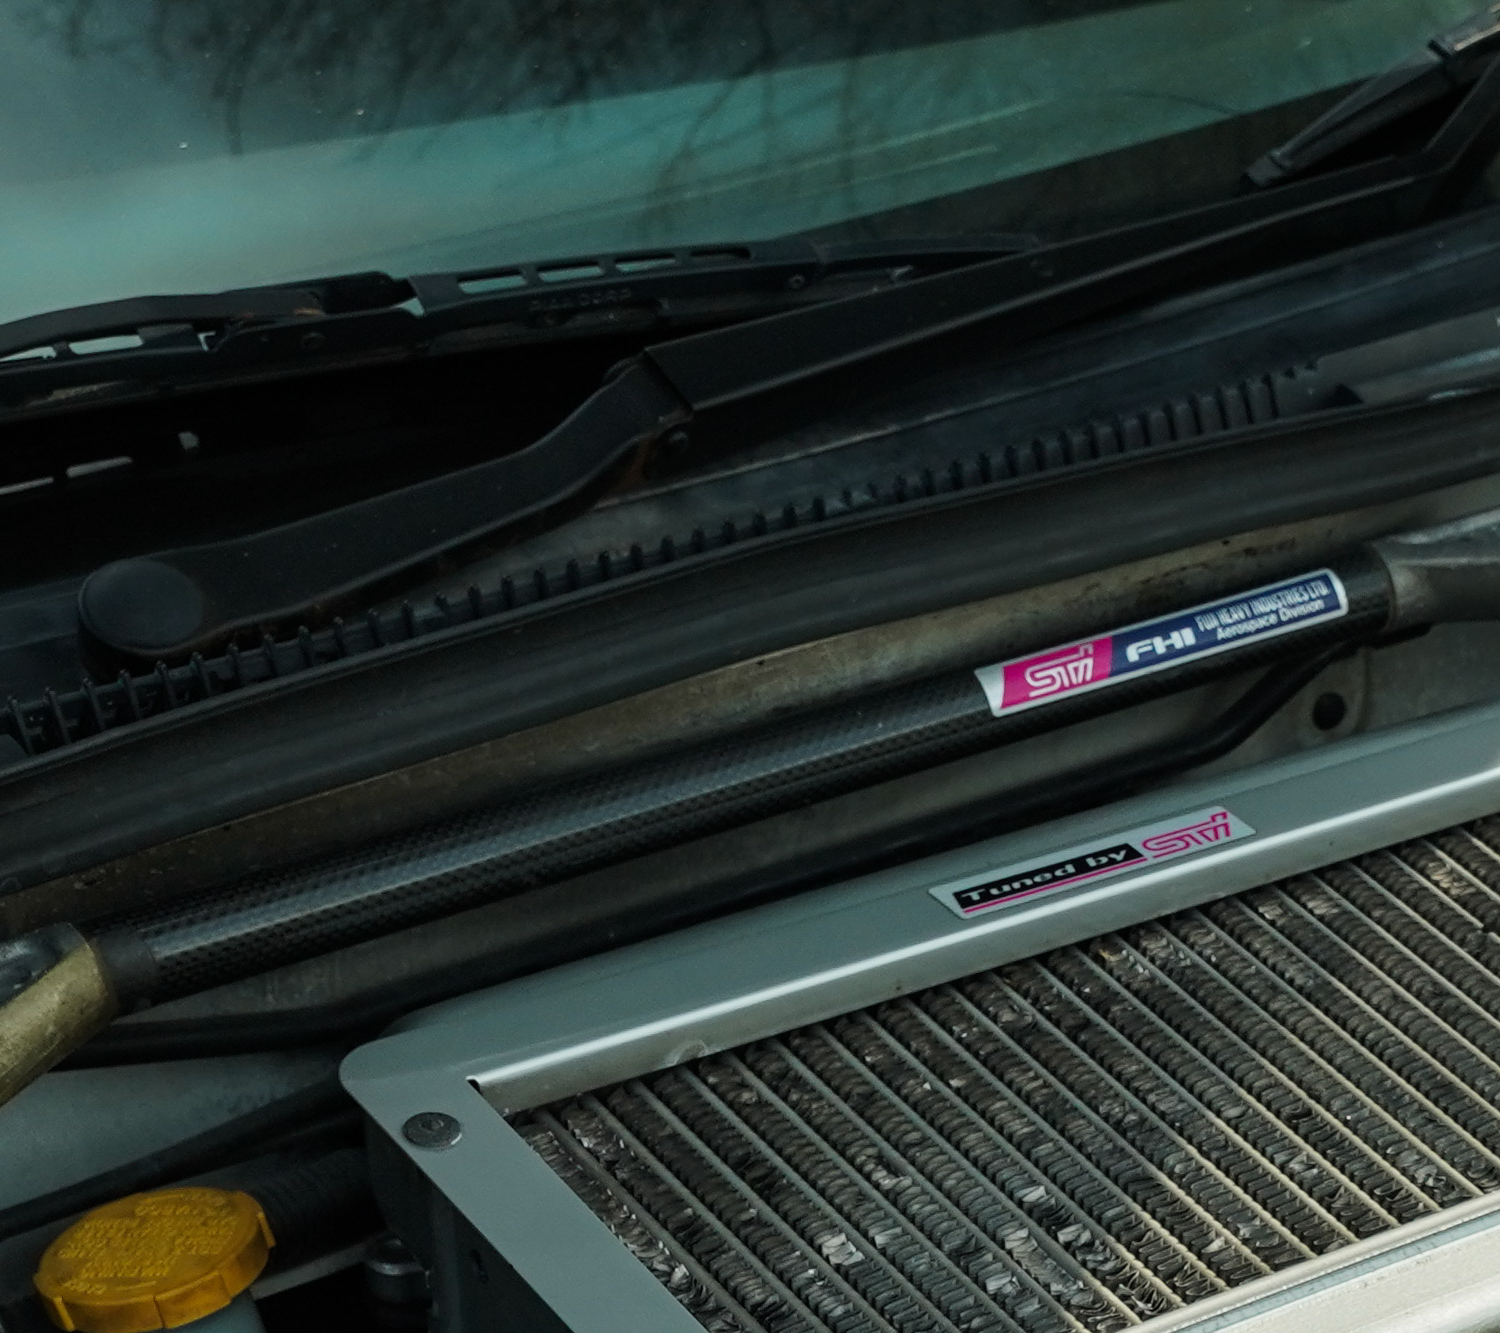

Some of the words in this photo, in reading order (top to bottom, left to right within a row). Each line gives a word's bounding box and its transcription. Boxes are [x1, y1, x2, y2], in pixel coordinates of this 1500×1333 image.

[1215, 612, 1279, 641] Aerospace
[1278, 598, 1326, 624] Division
[1218, 602, 1252, 627] HEAVY
[1249, 587, 1309, 617] INDUSTRIES
[1126, 626, 1196, 662] FHI
[961, 864, 1077, 902] Tuned
[1085, 849, 1128, 868] by
